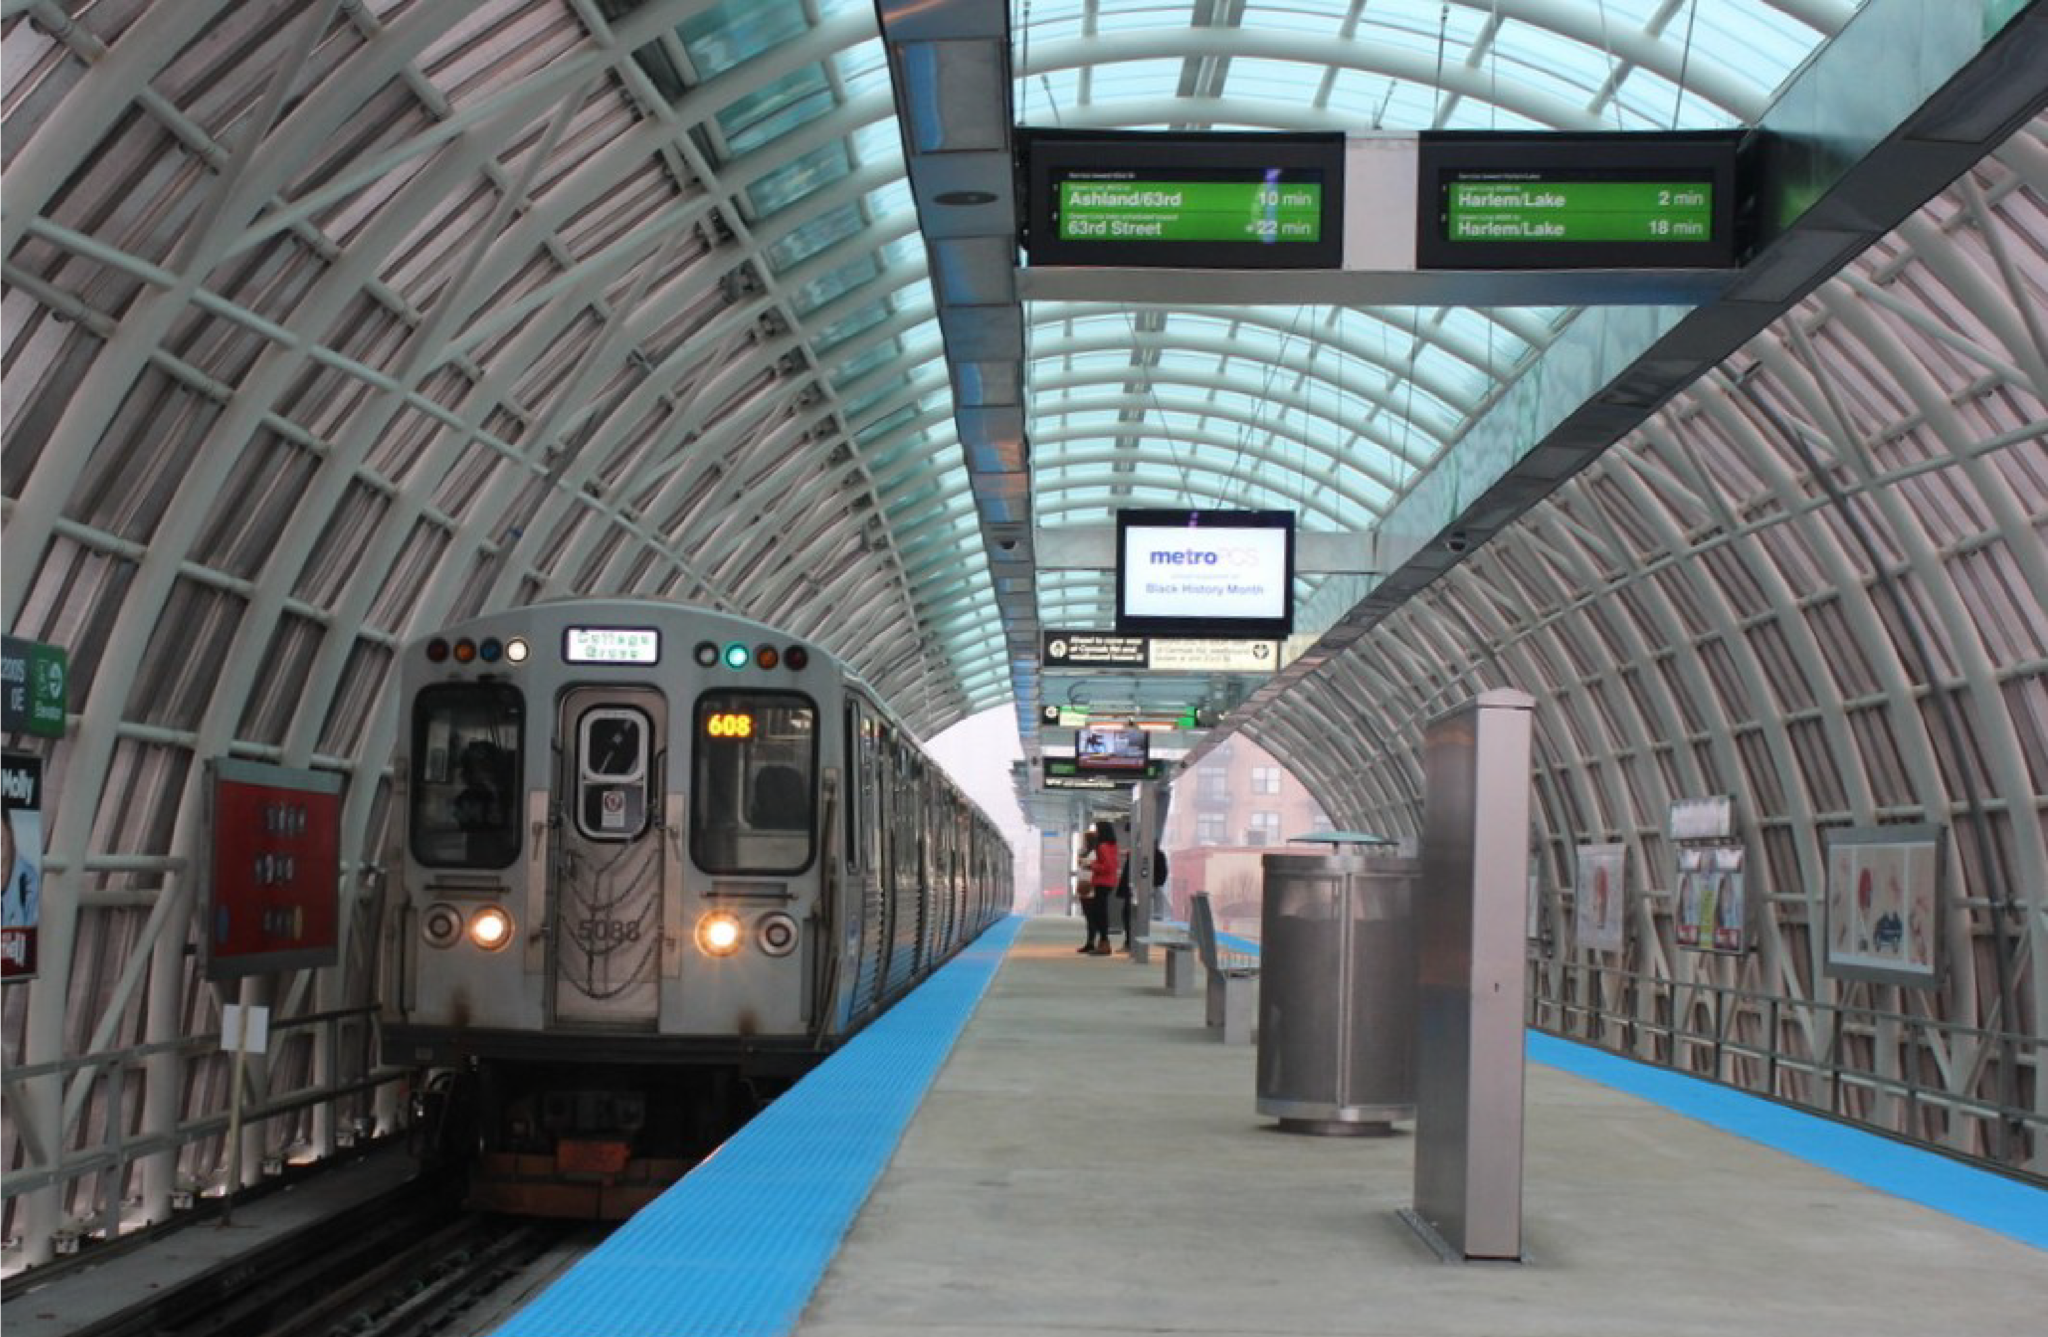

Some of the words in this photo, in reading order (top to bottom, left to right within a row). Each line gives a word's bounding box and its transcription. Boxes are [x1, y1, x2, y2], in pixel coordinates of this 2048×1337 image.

[1069, 191, 1182, 207] Ashland/63rd
[1259, 191, 1279, 206] 10
[1282, 189, 1312, 206] min
[1458, 192, 1566, 207] Harlem/Lake
[1658, 190, 1670, 206] 2
[1673, 189, 1704, 206] min
[1068, 220, 1106, 236] 63rd
[1111, 220, 1162, 236] Street
[1281, 219, 1312, 235] min
[1458, 221, 1566, 236] Harlem/Lake
[1648, 219, 1669, 235] 18
[1673, 219, 1704, 235] min
[1145, 582, 1178, 594] Black
[1182, 583, 1224, 597] History
[1226, 583, 1264, 595] Month
[709, 714, 751, 736] 608
[579, 921, 641, 941] 5088
